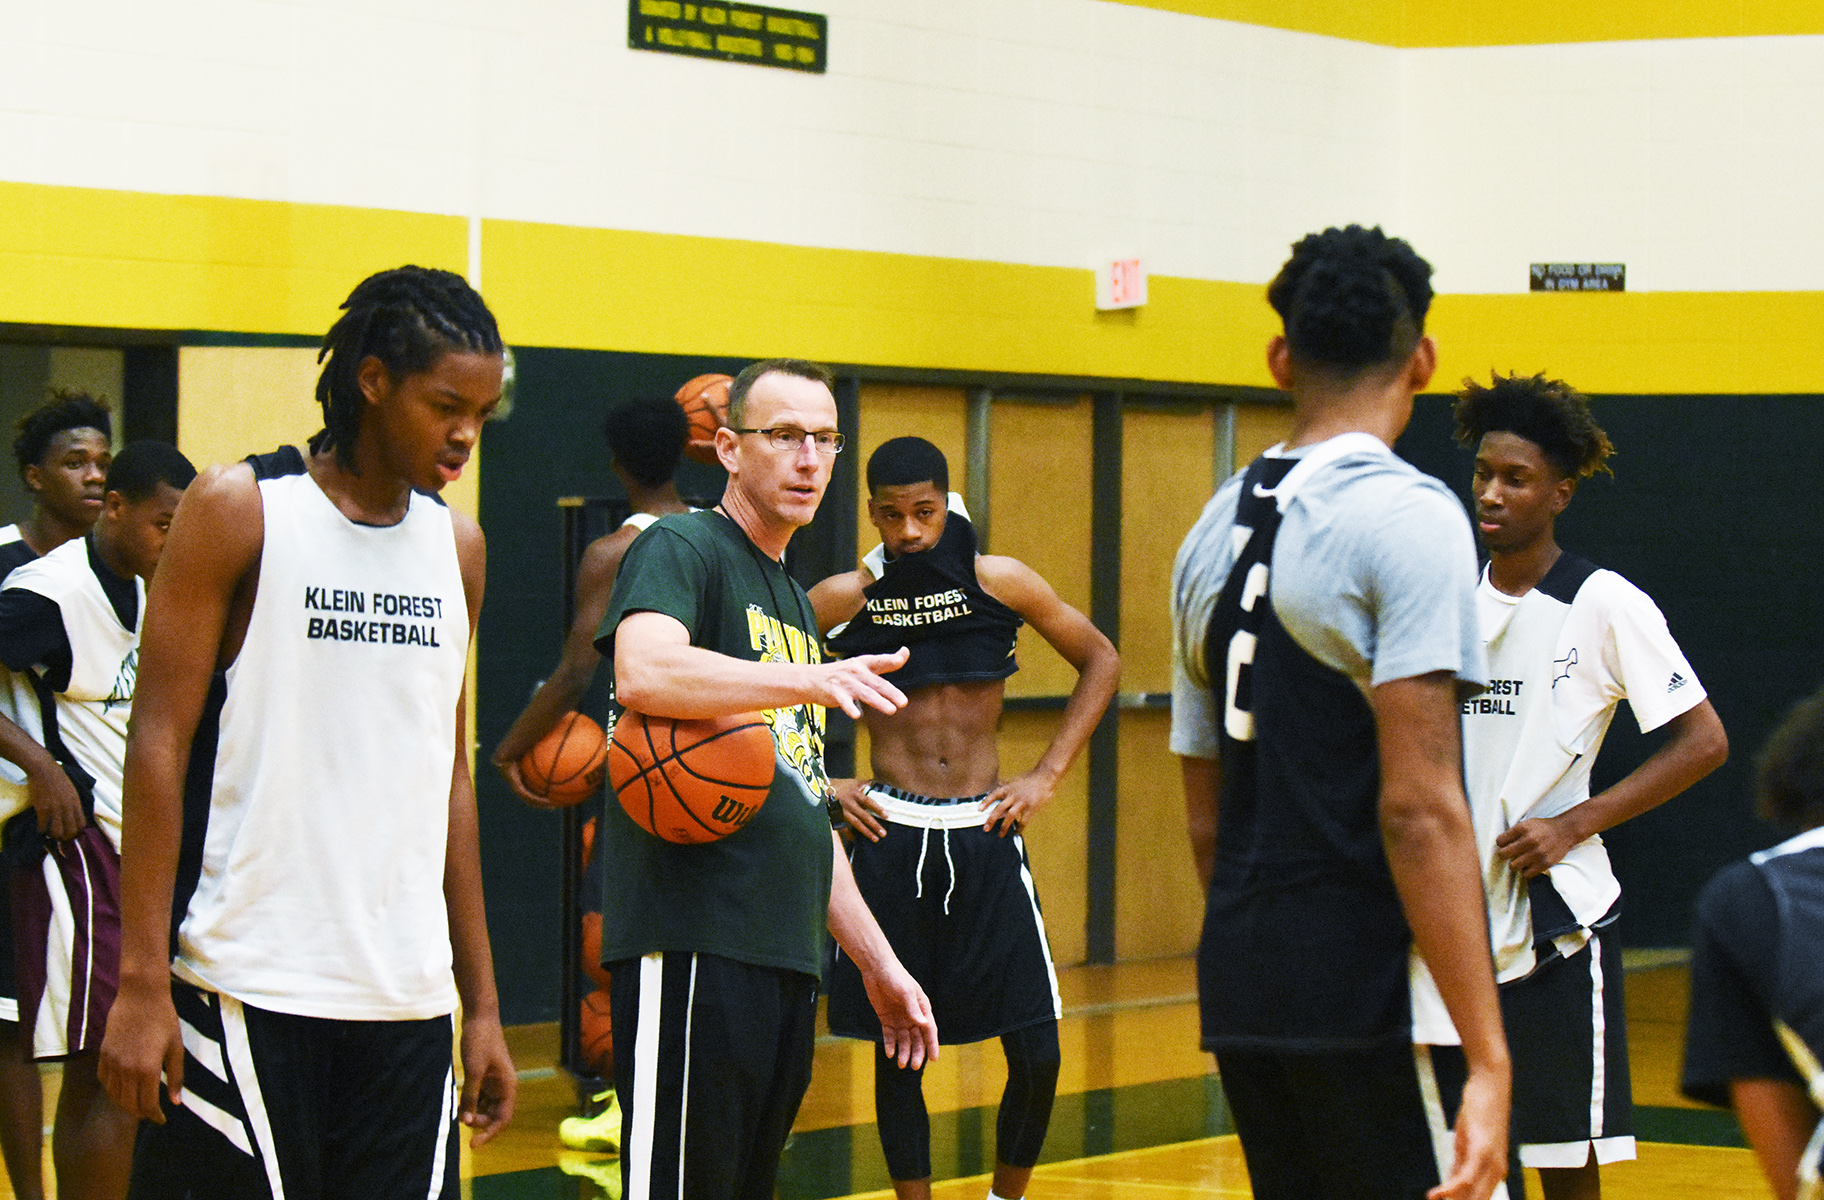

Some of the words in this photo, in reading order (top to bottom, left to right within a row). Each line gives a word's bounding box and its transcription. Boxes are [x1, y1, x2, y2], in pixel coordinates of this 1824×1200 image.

[305, 586, 365, 613] KLEIN
[373, 593, 442, 619] FOREST
[867, 598, 909, 612] KLEIN
[914, 588, 968, 610] FOREST
[872, 603, 972, 627] BASKETBALL
[307, 617, 440, 648] BASKETBALL
[1485, 679, 1523, 696] REST
[1462, 698, 1516, 716] ETBALL
